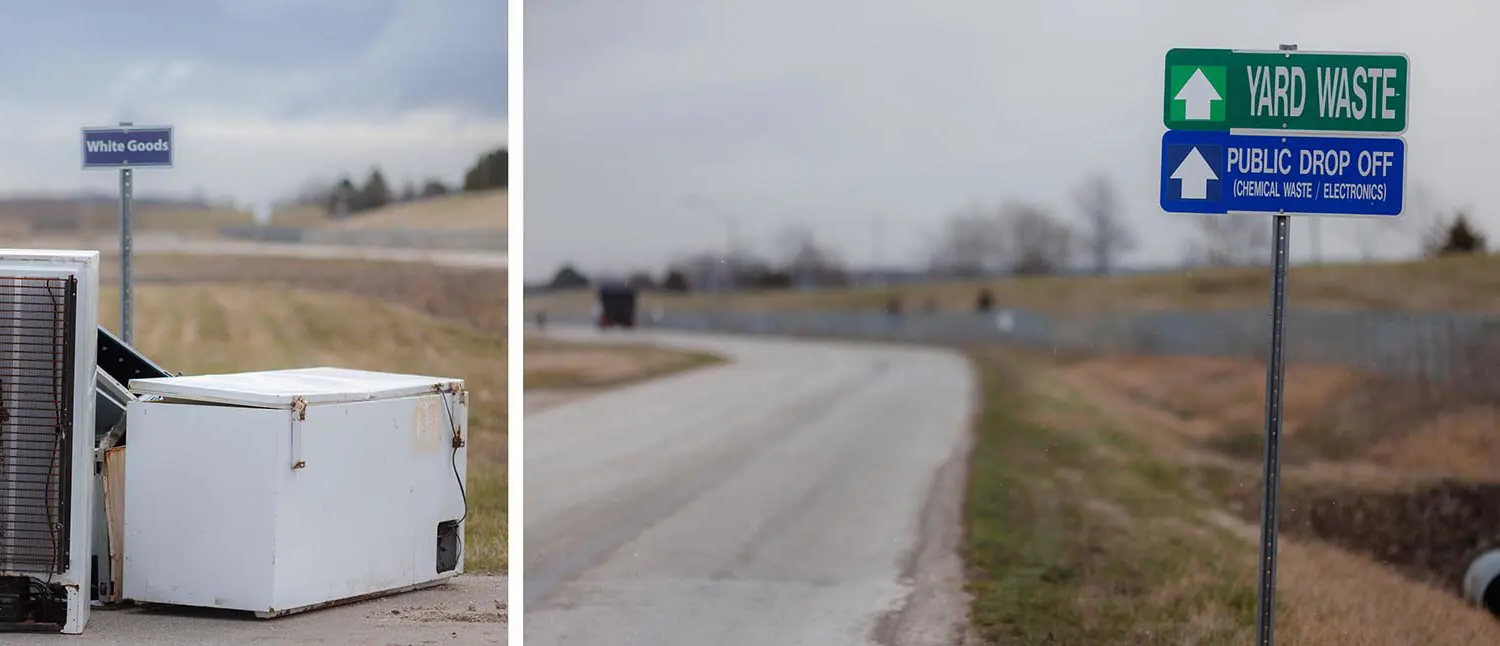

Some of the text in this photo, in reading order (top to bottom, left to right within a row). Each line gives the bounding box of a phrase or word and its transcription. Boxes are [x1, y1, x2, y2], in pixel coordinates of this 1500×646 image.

[1246, 65, 1397, 120] YARD WASTE
[86, 138, 169, 152] White Goods
[1227, 147, 1394, 177] PUBLIC DROP OFF
[1233, 179, 1280, 198] (CHEMICAL
[1283, 182, 1312, 199] WASTE
[1323, 183, 1387, 202] ELECTRONICS)
